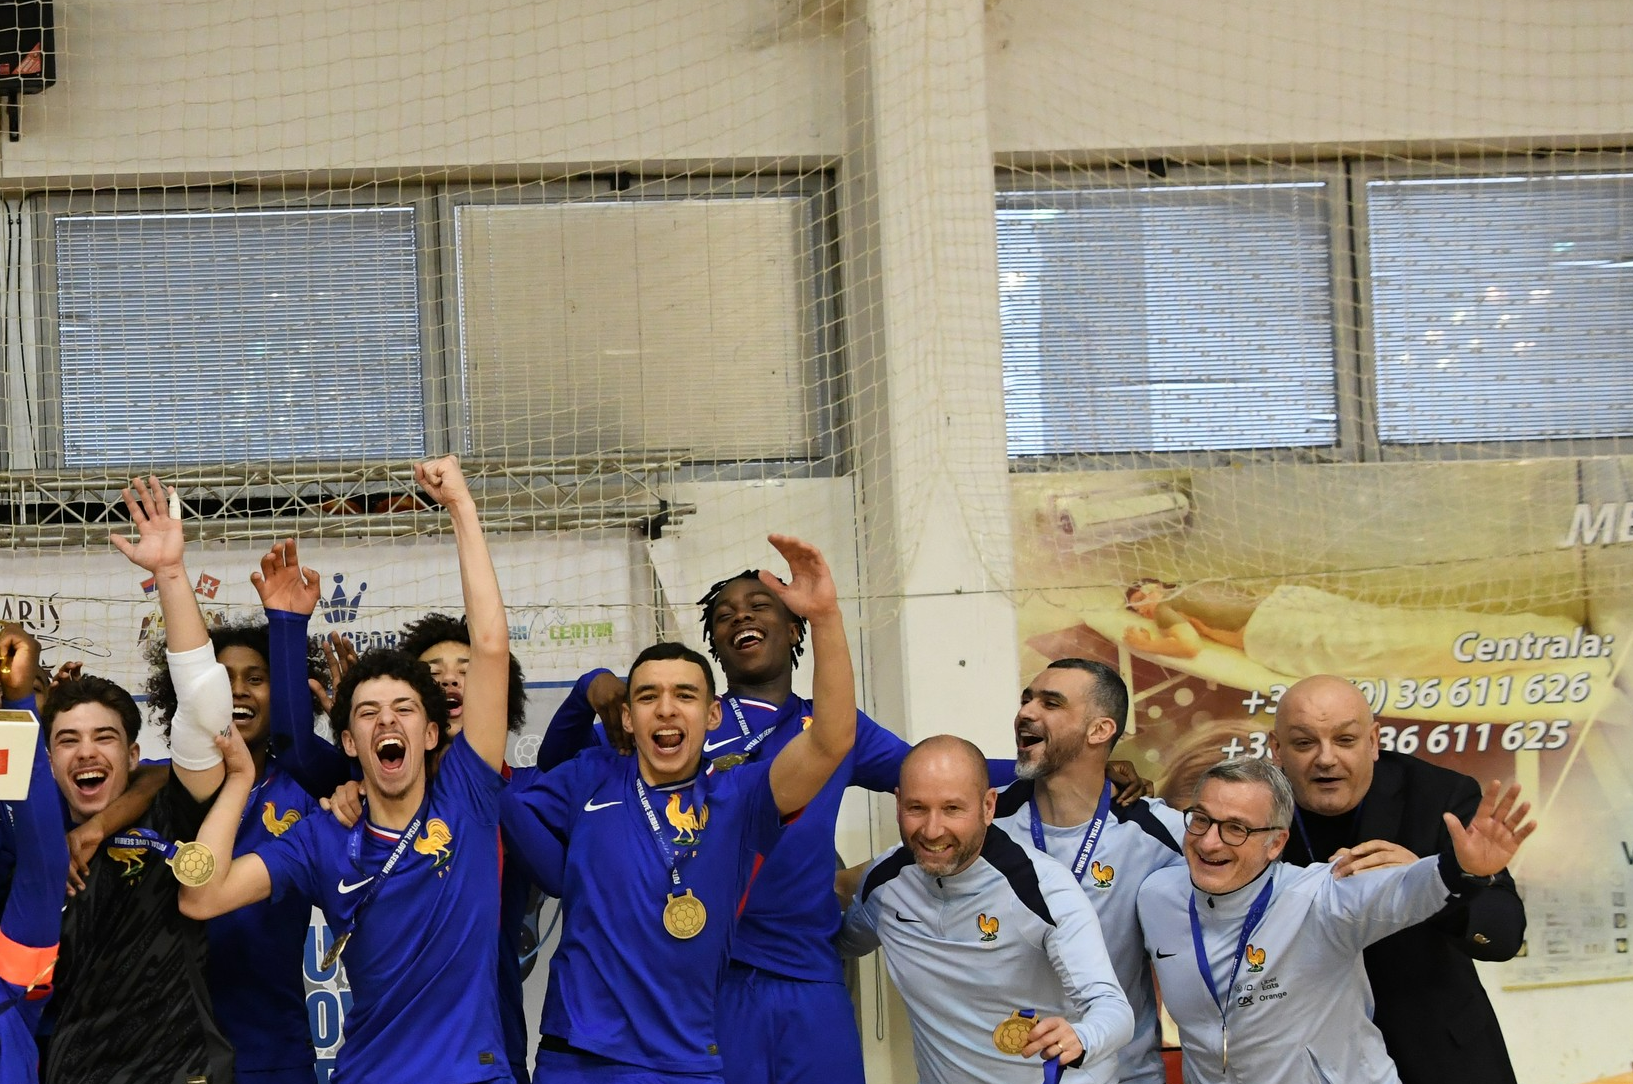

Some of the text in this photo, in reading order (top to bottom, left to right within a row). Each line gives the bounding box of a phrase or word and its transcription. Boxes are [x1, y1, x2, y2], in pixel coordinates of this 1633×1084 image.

[1453, 626, 1614, 663] Centrala:
[1394, 679, 1441, 709] 36
[1448, 676, 1513, 708] 611
[1522, 672, 1591, 704] 626
[1426, 723, 1494, 754] 611
[1501, 719, 1570, 751] 625
[641, 797, 650, 813] LOVE
[646, 808, 660, 832] SERBIA
[135, 838, 150, 847] LOVE
[381, 818, 421, 875] FUTSAL LOVE SERBIA
[1074, 818, 1103, 874] FUTSAL LOVE SERBIA
[1259, 991, 1288, 1002] Orange
